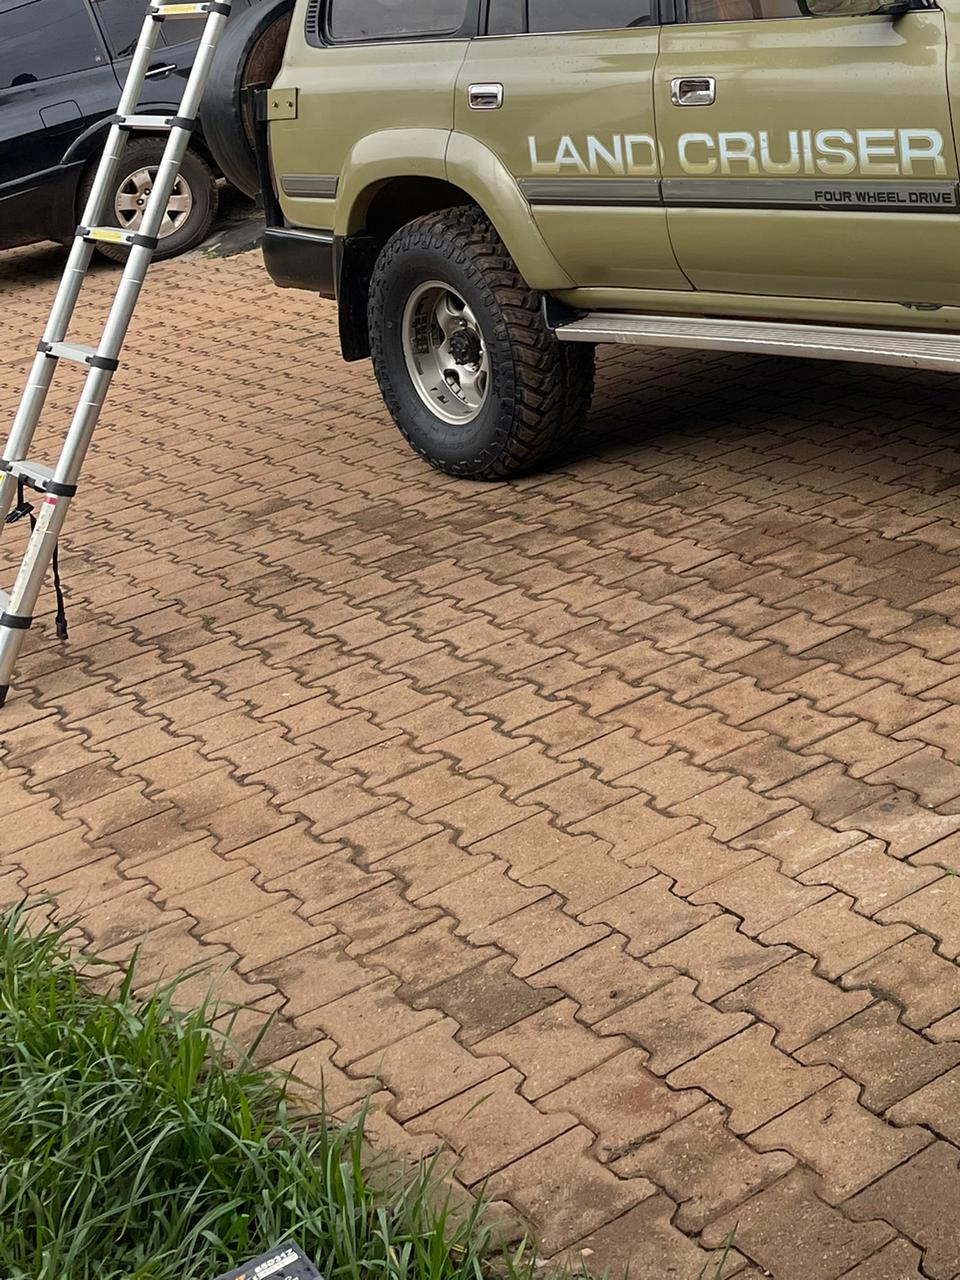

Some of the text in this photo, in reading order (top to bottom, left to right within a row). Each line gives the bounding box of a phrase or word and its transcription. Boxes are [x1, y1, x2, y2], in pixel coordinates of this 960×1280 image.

[528, 128, 948, 176] LAND CRUISER
[814, 191, 953, 204] FOUR WHEEL DRIVE
